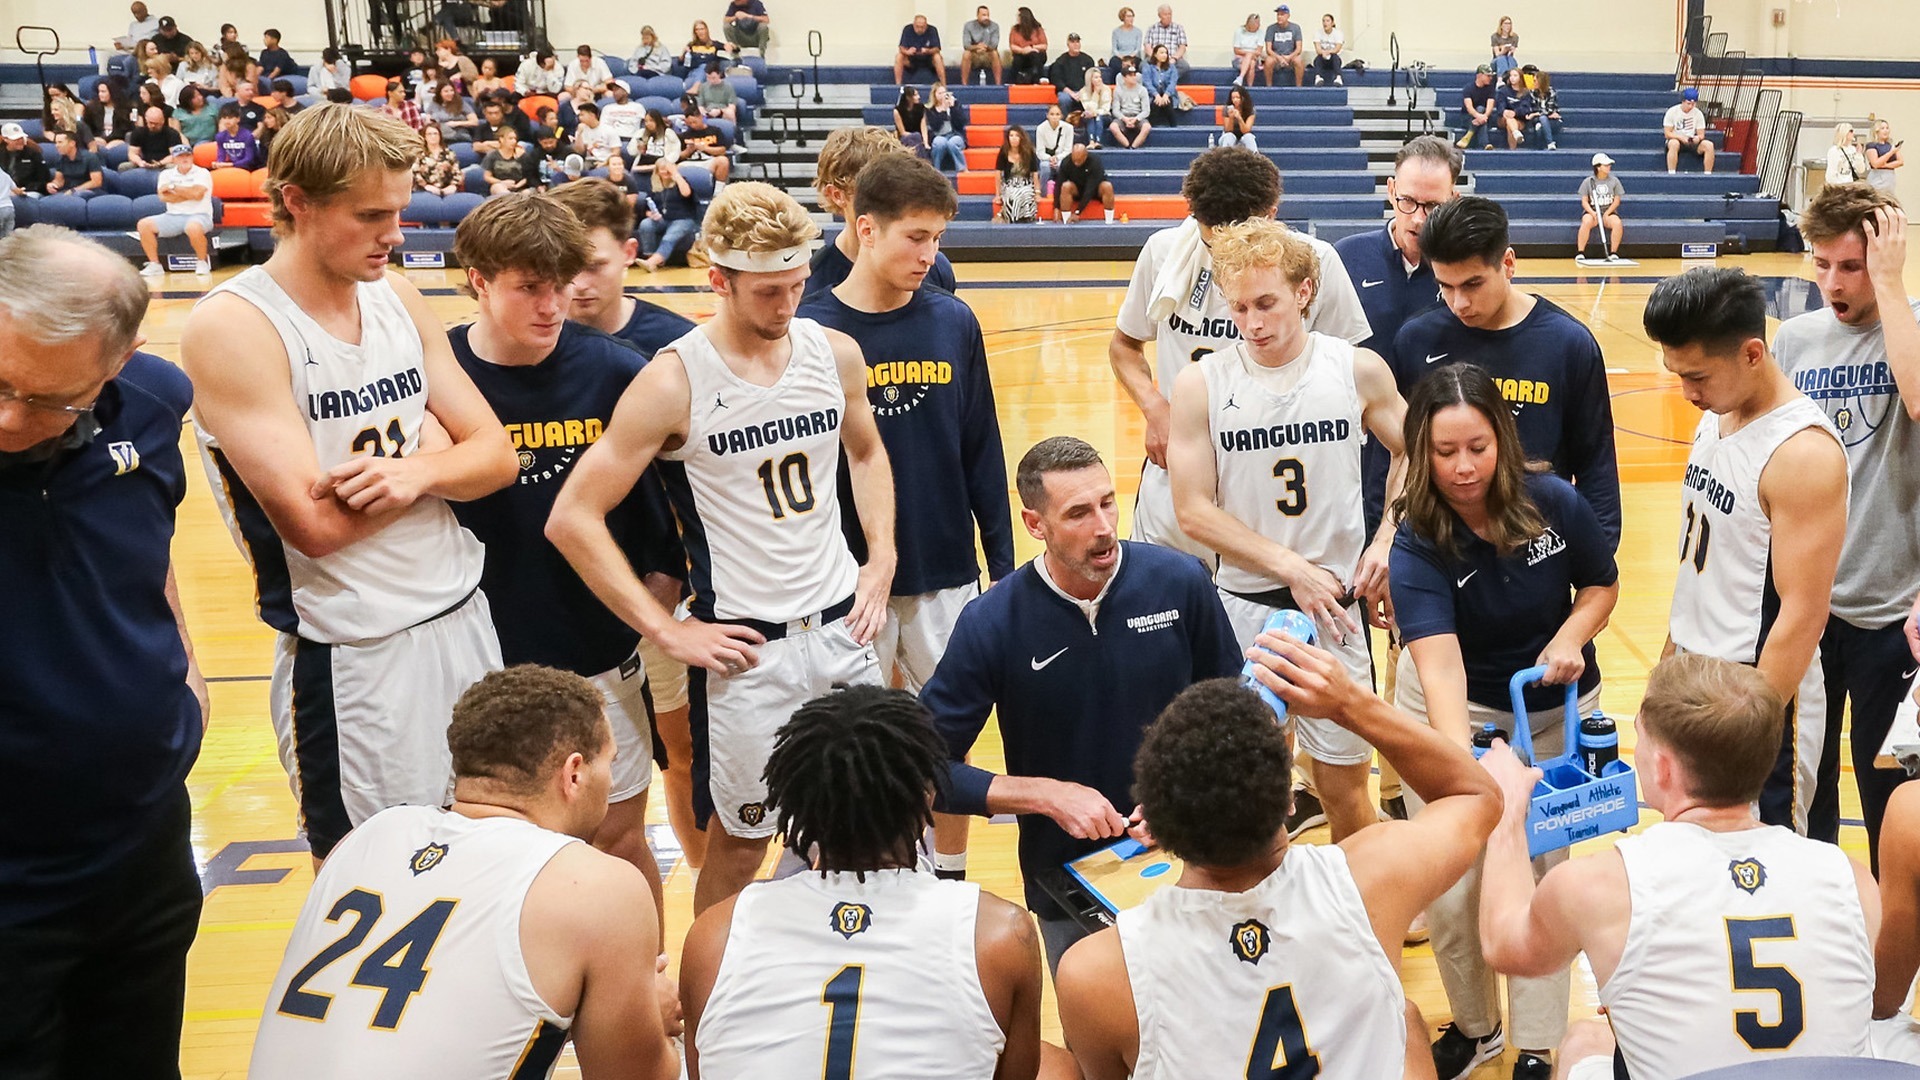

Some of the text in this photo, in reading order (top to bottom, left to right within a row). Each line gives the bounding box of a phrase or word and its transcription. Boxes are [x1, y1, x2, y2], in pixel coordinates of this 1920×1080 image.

[1190, 270, 1210, 308] GSAC
[308, 367, 422, 421] VANGUARD
[707, 408, 838, 456] VANGUARD
[1220, 419, 1350, 452] VANGUARD
[757, 450, 816, 520] 10
[1272, 454, 1308, 518] 3
[1126, 609, 1180, 629] VANGUARD
[1533, 796, 1626, 835] POWERADE
[1588, 783, 1622, 803] Athletic
[276, 885, 462, 1032] 24
[1722, 913, 1807, 1053] 5
[820, 963, 866, 1080] 1
[1244, 982, 1323, 1080] 4
